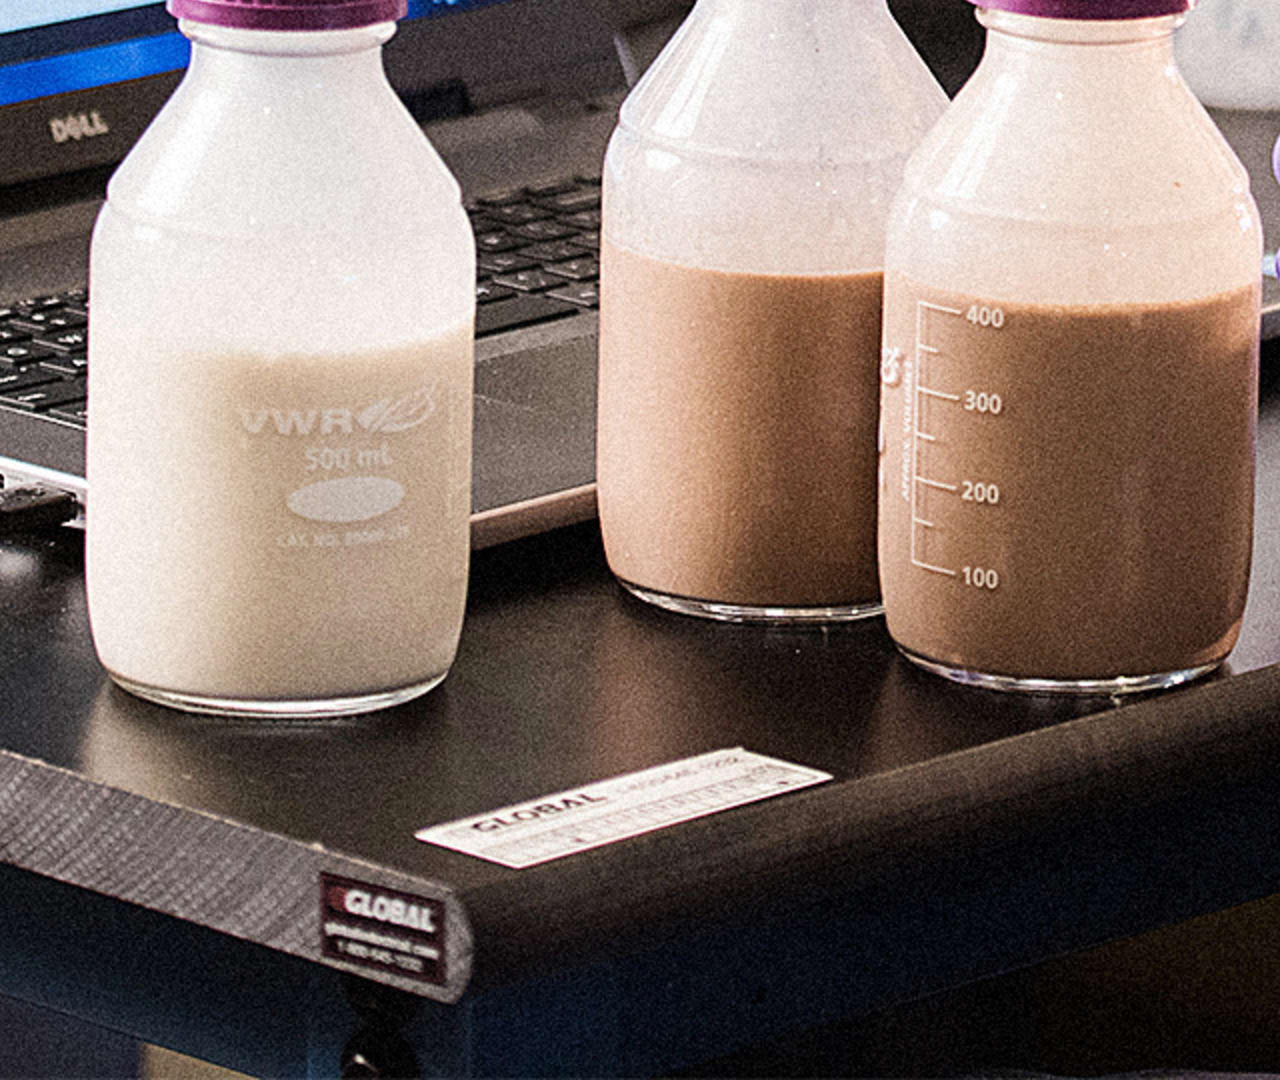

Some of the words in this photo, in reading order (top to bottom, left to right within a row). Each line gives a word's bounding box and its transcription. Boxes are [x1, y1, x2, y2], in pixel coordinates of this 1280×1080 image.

[48, 110, 109, 144] DELL
[965, 305, 1004, 328] 400
[963, 390, 1002, 415] 300
[237, 406, 354, 436] VWR
[305, 446, 350, 472] 500
[961, 481, 1000, 505] 200
[961, 566, 999, 590] 100
[471, 792, 608, 834] GLOBAL
[344, 888, 436, 933] GLOBAL
